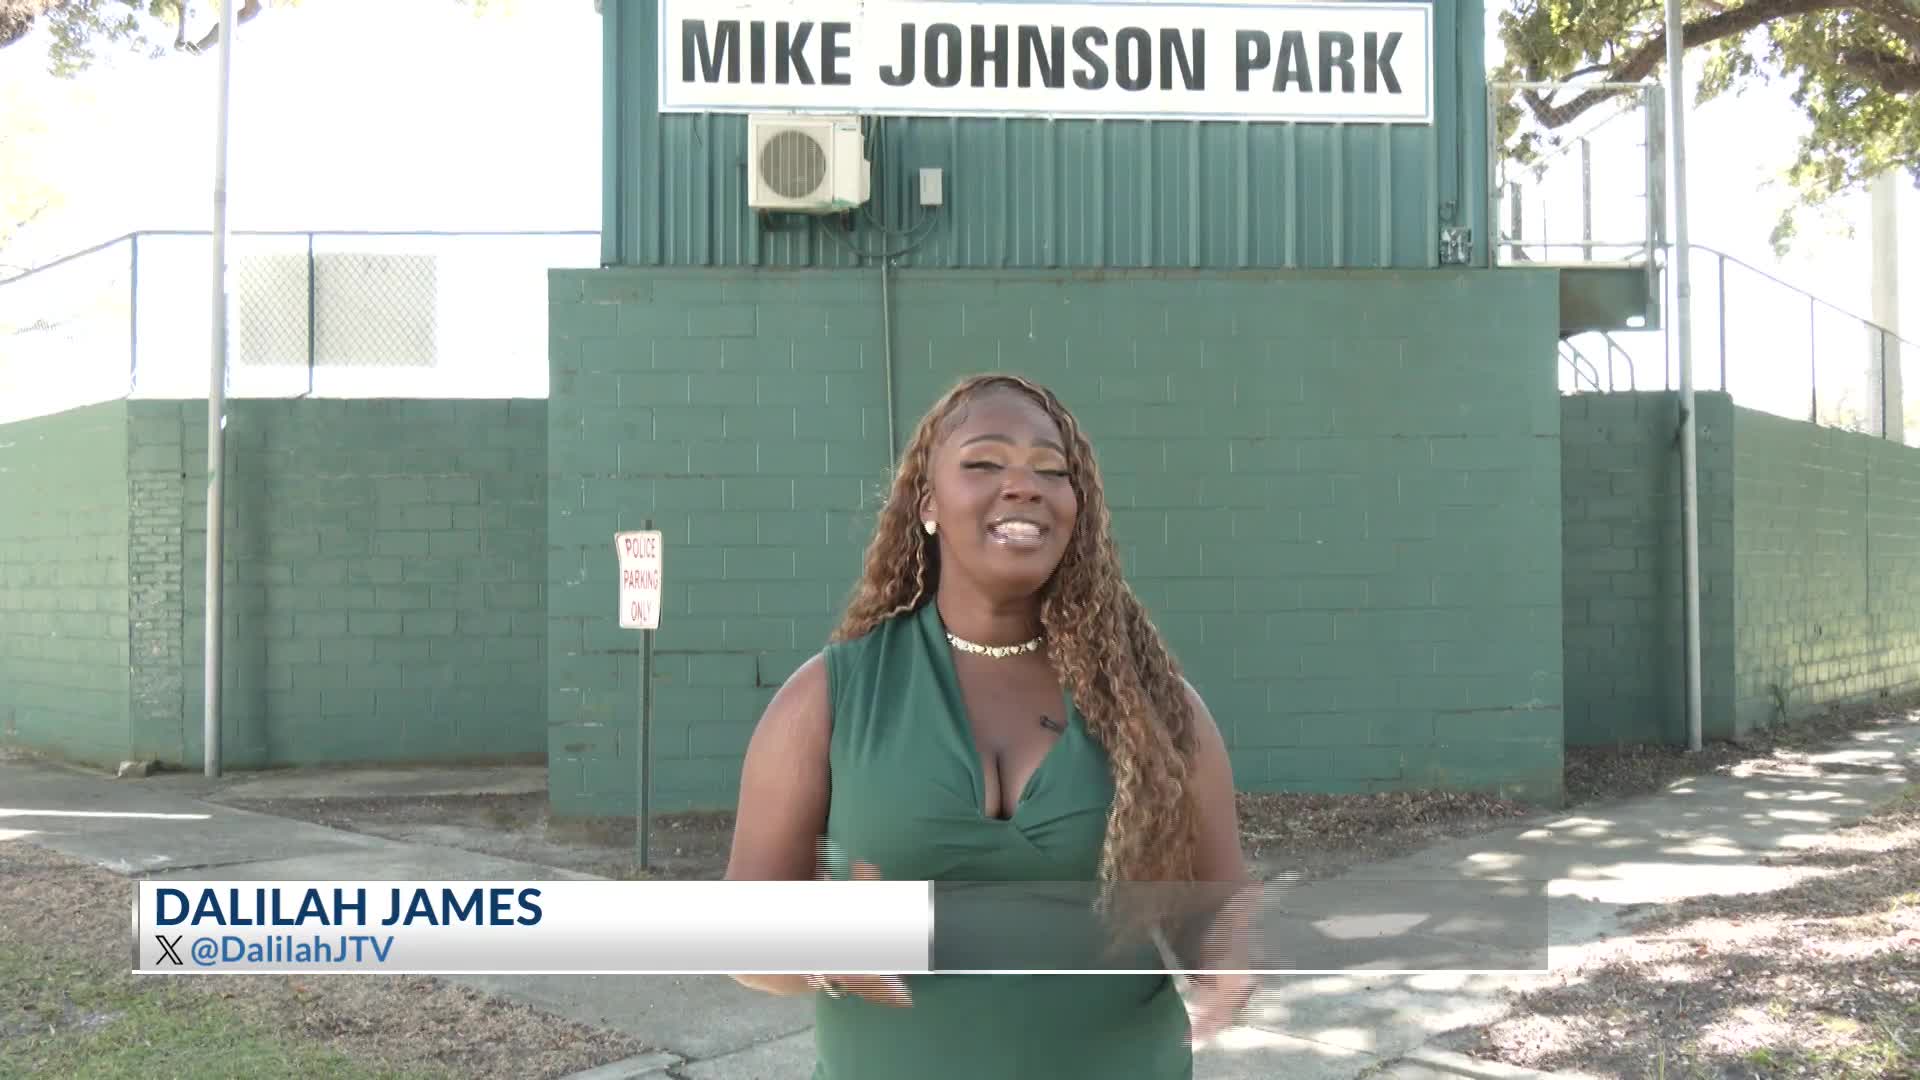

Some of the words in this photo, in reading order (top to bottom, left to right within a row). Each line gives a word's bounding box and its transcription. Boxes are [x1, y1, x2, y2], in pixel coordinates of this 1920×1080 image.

[682, 19, 851, 84] MIKE
[879, 24, 1205, 90] JOHNSON
[1236, 30, 1402, 93] PARK
[625, 538, 655, 558] POLICE
[623, 569, 658, 590] PARKING
[631, 600, 651, 621] ONLY
